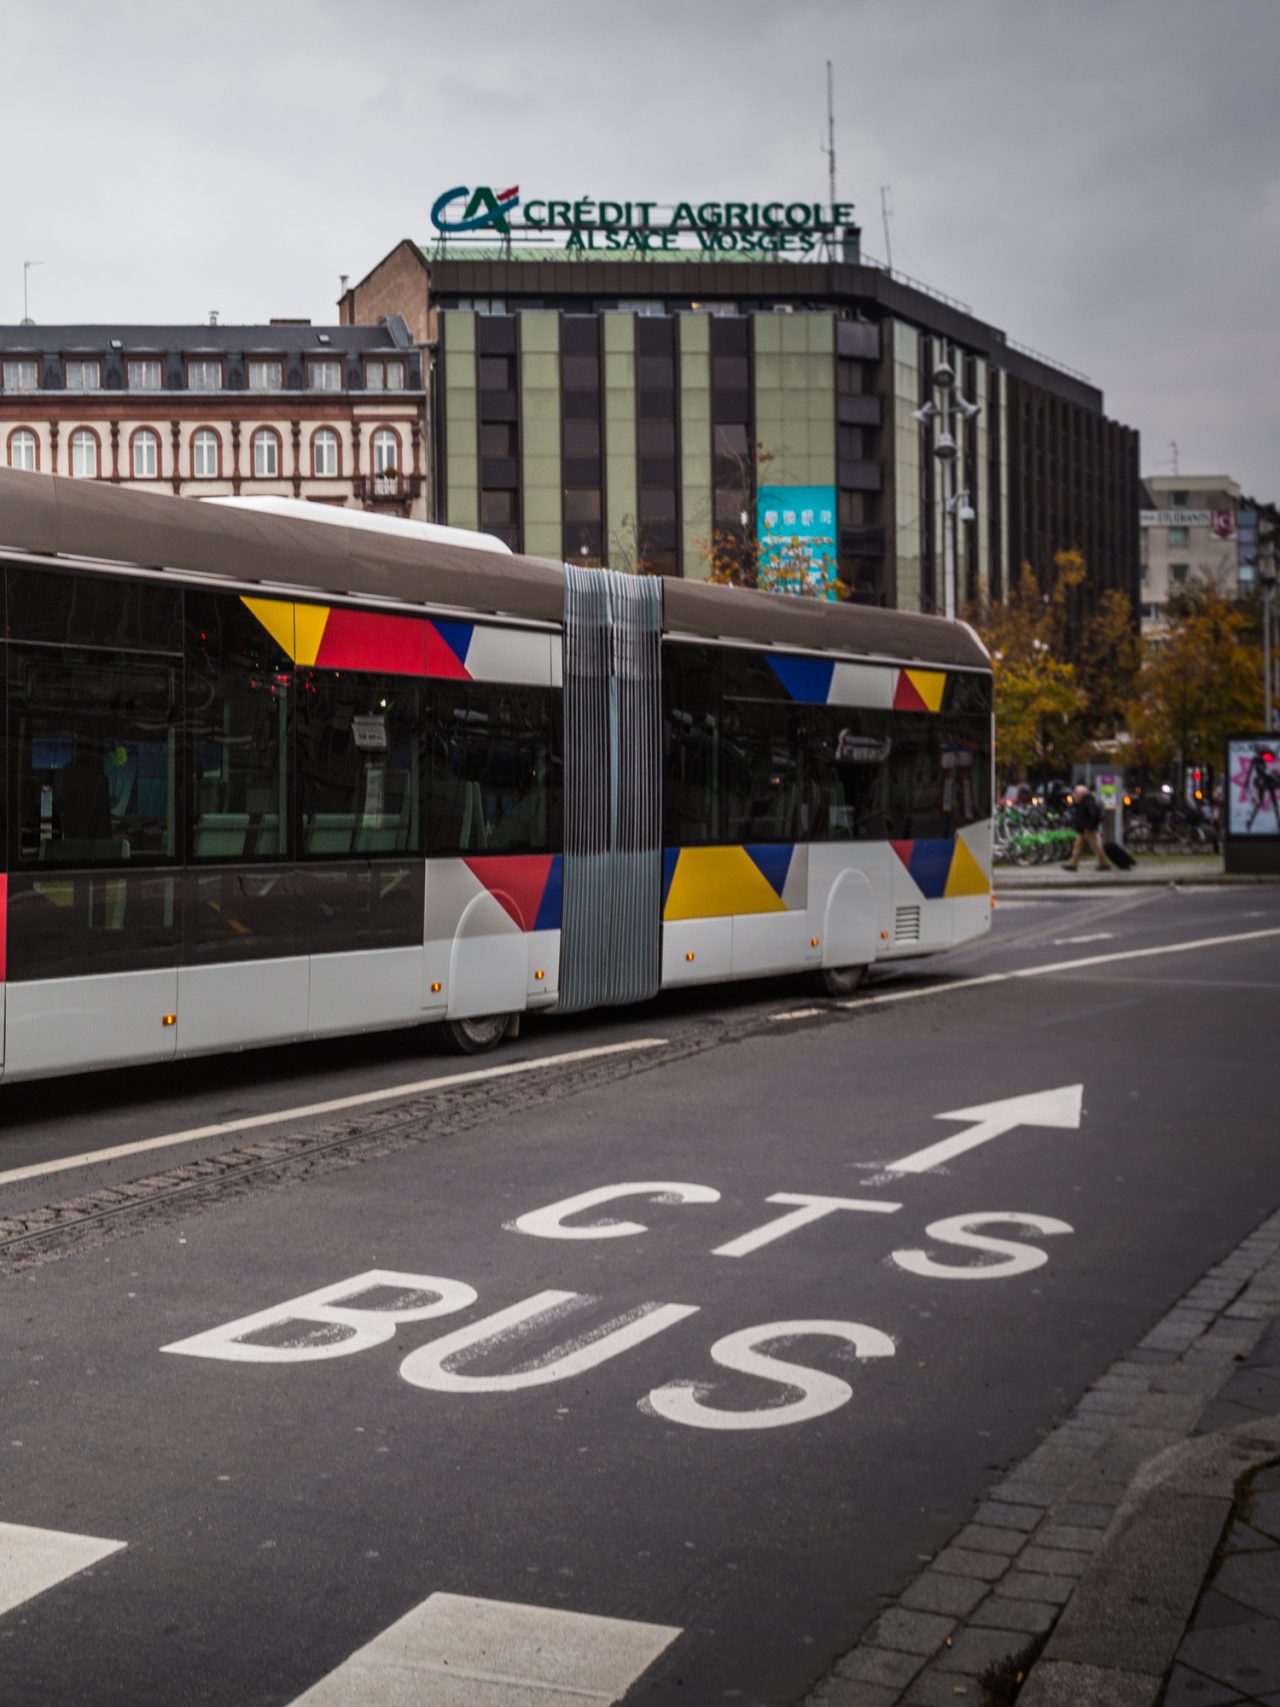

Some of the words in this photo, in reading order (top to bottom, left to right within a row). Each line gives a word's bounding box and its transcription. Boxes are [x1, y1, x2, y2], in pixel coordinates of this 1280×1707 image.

[523, 195, 656, 227] CRÉDIT
[671, 201, 856, 228] AGRICOLE
[565, 230, 680, 251] ALSACE
[702, 230, 817, 251] VOSGES
[514, 1181, 1076, 1279] CTS
[158, 1268, 897, 1431] BUS
